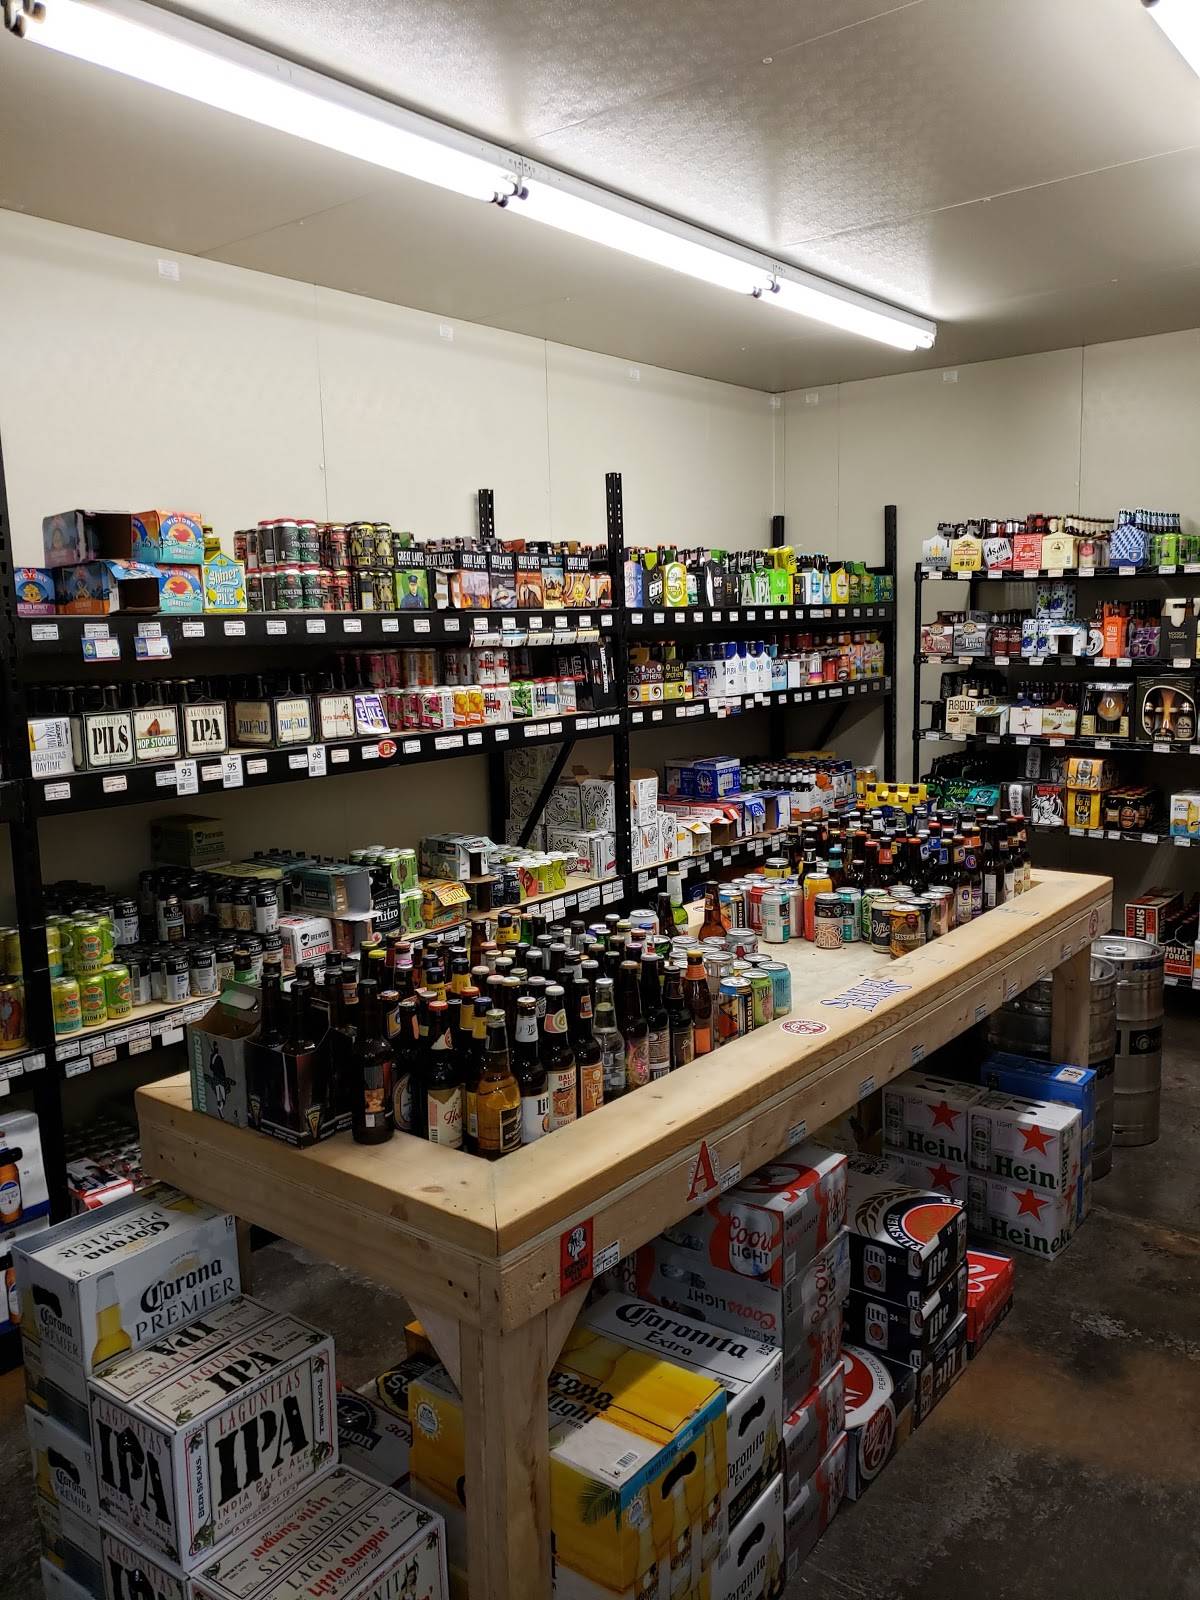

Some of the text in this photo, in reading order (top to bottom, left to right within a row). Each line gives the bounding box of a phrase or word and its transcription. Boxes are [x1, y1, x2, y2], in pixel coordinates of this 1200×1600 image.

[167, 517, 195, 527] VICTORY
[397, 551, 424, 561] GREAT LAKES
[439, 553, 454, 566] LAKES
[473, 555, 486, 565] LAKES
[500, 556, 513, 565] LAKES
[528, 556, 540, 565] LAKES
[579, 558, 589, 566] LAKES
[986, 541, 1008, 558] Asahi
[216, 593, 235, 605] PILS
[92, 725, 129, 755] PILS
[137, 736, 177, 750] HOP STOOPID
[191, 718, 222, 742] IPA
[35, 761, 61, 772] DAYTIME
[227, 763, 237, 771] 95
[312, 751, 321, 760] 98
[182, 769, 192, 777] 93
[310, 930, 330, 941] BREWDOG
[1136, 908, 1145, 937] SMITH
[302, 947, 314, 958] LOST
[1166, 946, 1188, 955] MITH
[907, 1131, 967, 1164] Hein
[687, 1141, 718, 1201] A
[995, 1155, 1059, 1190] Hein
[58, 1211, 163, 1258] PREMIER
[224, 1215, 234, 1228] 12
[887, 1213, 925, 1251] PILSNER
[84, 1221, 170, 1261] Corona
[732, 1247, 769, 1265] LIGHT
[865, 1248, 886, 1264] Lite
[888, 1256, 897, 1264] 24
[928, 1248, 949, 1287] Lite
[140, 1258, 223, 1313] Corona
[687, 1288, 727, 1311] LIGHT
[40, 1306, 73, 1337] Corona
[135, 1277, 235, 1341] PREMIER
[728, 1300, 776, 1330] Coors
[867, 1307, 887, 1322] Lite
[890, 1314, 898, 1322] 24
[615, 1304, 750, 1360] Coronita
[928, 1304, 949, 1344] Lite
[148, 1320, 244, 1378] LAGUNITAS
[645, 1329, 693, 1357] Extra
[758, 1344, 774, 1352] 24
[176, 1331, 274, 1391] LAGUNITAS
[206, 1351, 283, 1396] IPA
[218, 1370, 301, 1436] LAGUNITAS
[99, 1406, 163, 1456] LAGUNITAS
[214, 1396, 309, 1506] IPA
[727, 1431, 765, 1488] oronita
[56, 1468, 86, 1499] Corona
[96, 1419, 172, 1525] IPA
[217, 1492, 250, 1520] INDIA
[255, 1468, 283, 1494] PALE
[289, 1451, 309, 1468] ALE
[300, 1495, 332, 1523] Little
[258, 1501, 354, 1575] LAGUNITAS
[285, 1511, 380, 1591] LAGUNITAS
[307, 1568, 346, 1598] Little
[342, 1526, 388, 1568] Sumpin'
